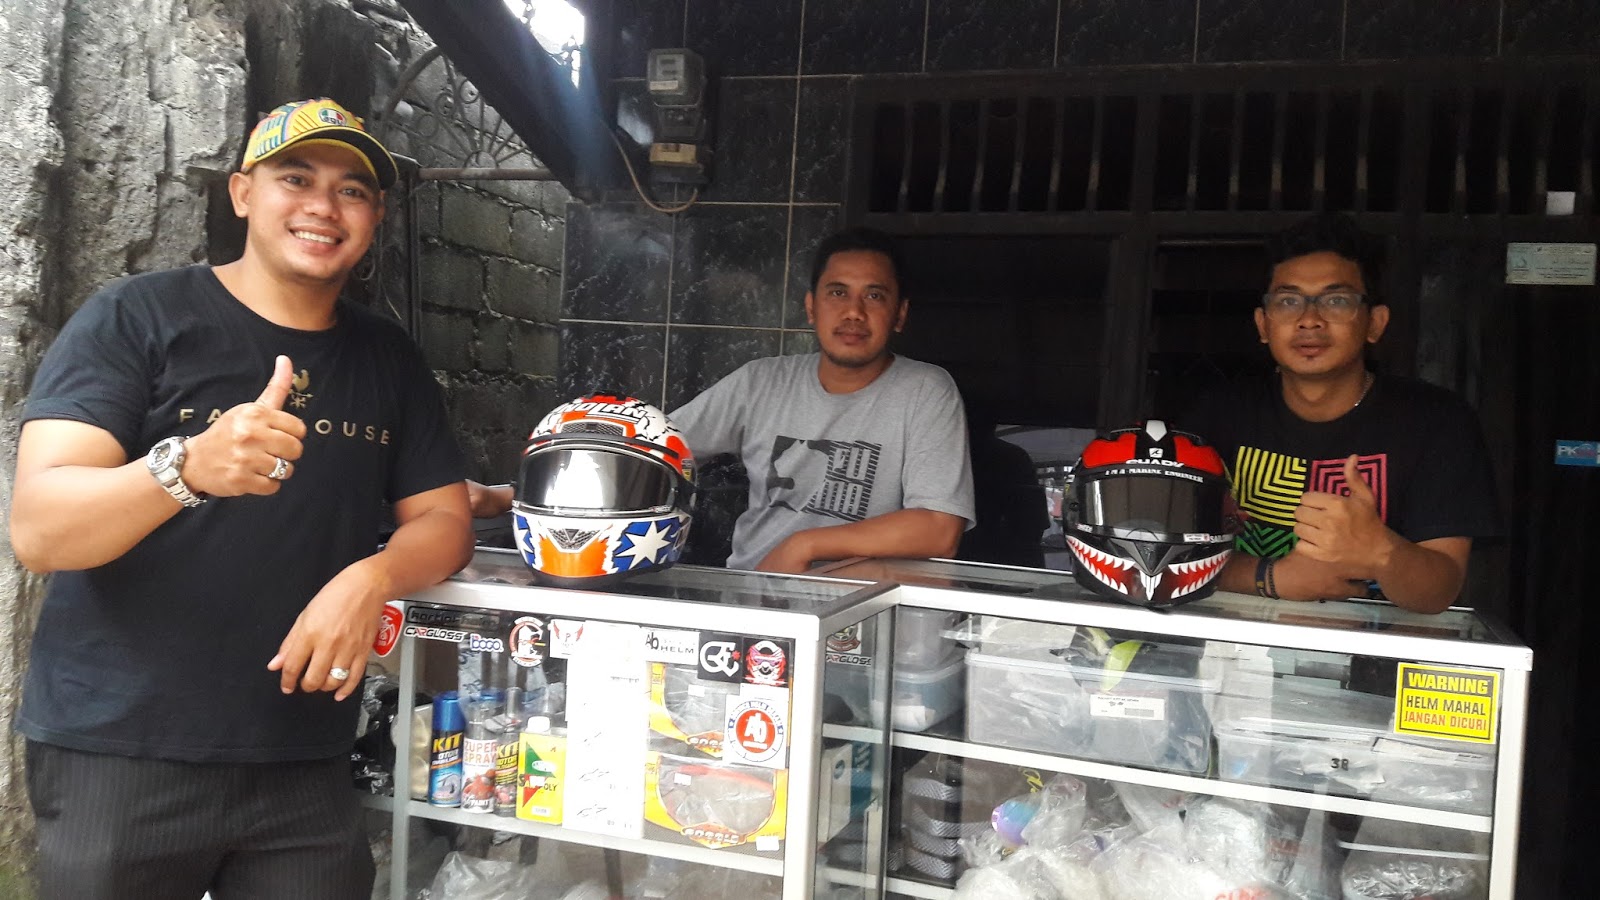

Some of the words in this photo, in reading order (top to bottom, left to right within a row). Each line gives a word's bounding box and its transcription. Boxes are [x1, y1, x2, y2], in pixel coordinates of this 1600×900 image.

[561, 402, 648, 422] NOLAN
[1164, 470, 1204, 483] ENGINEER
[405, 627, 464, 641] CARGLOSS
[661, 645, 694, 653] HELM
[1408, 672, 1489, 695] WARNING
[1406, 695, 1438, 711] HELM
[1443, 699, 1486, 716] MAHAL
[1404, 711, 1446, 727] JANGAN
[1450, 716, 1487, 731] DICURI
[432, 733, 463, 753] KIT
[464, 751, 498, 764] SPRAY
